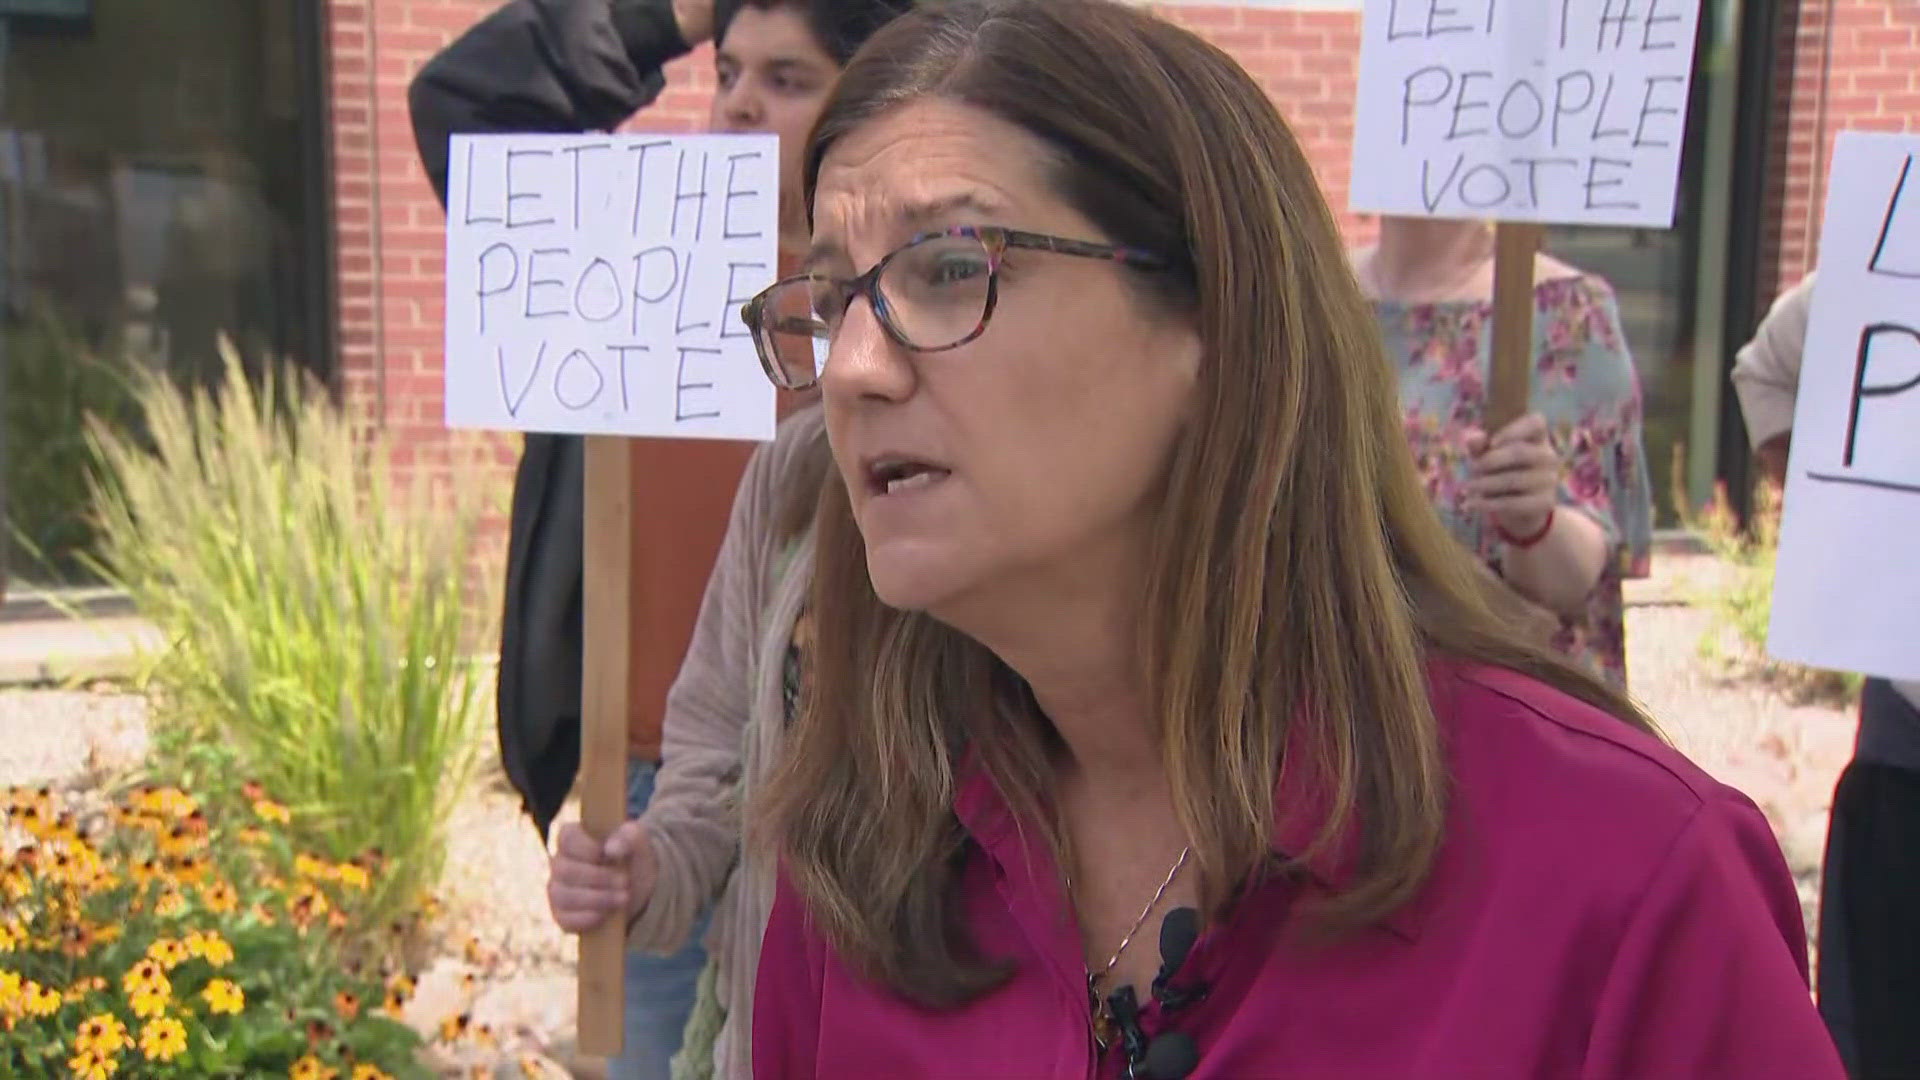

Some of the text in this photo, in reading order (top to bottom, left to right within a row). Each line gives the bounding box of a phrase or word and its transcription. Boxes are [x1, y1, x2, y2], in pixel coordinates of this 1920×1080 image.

[1559, 0, 1682, 52] THE
[1401, 65, 1685, 147] PEOPLE
[465, 140, 762, 242] LET THE
[1420, 153, 1640, 213] VOTE
[476, 242, 767, 339] PEOPLE
[497, 340, 723, 422] VOTE
